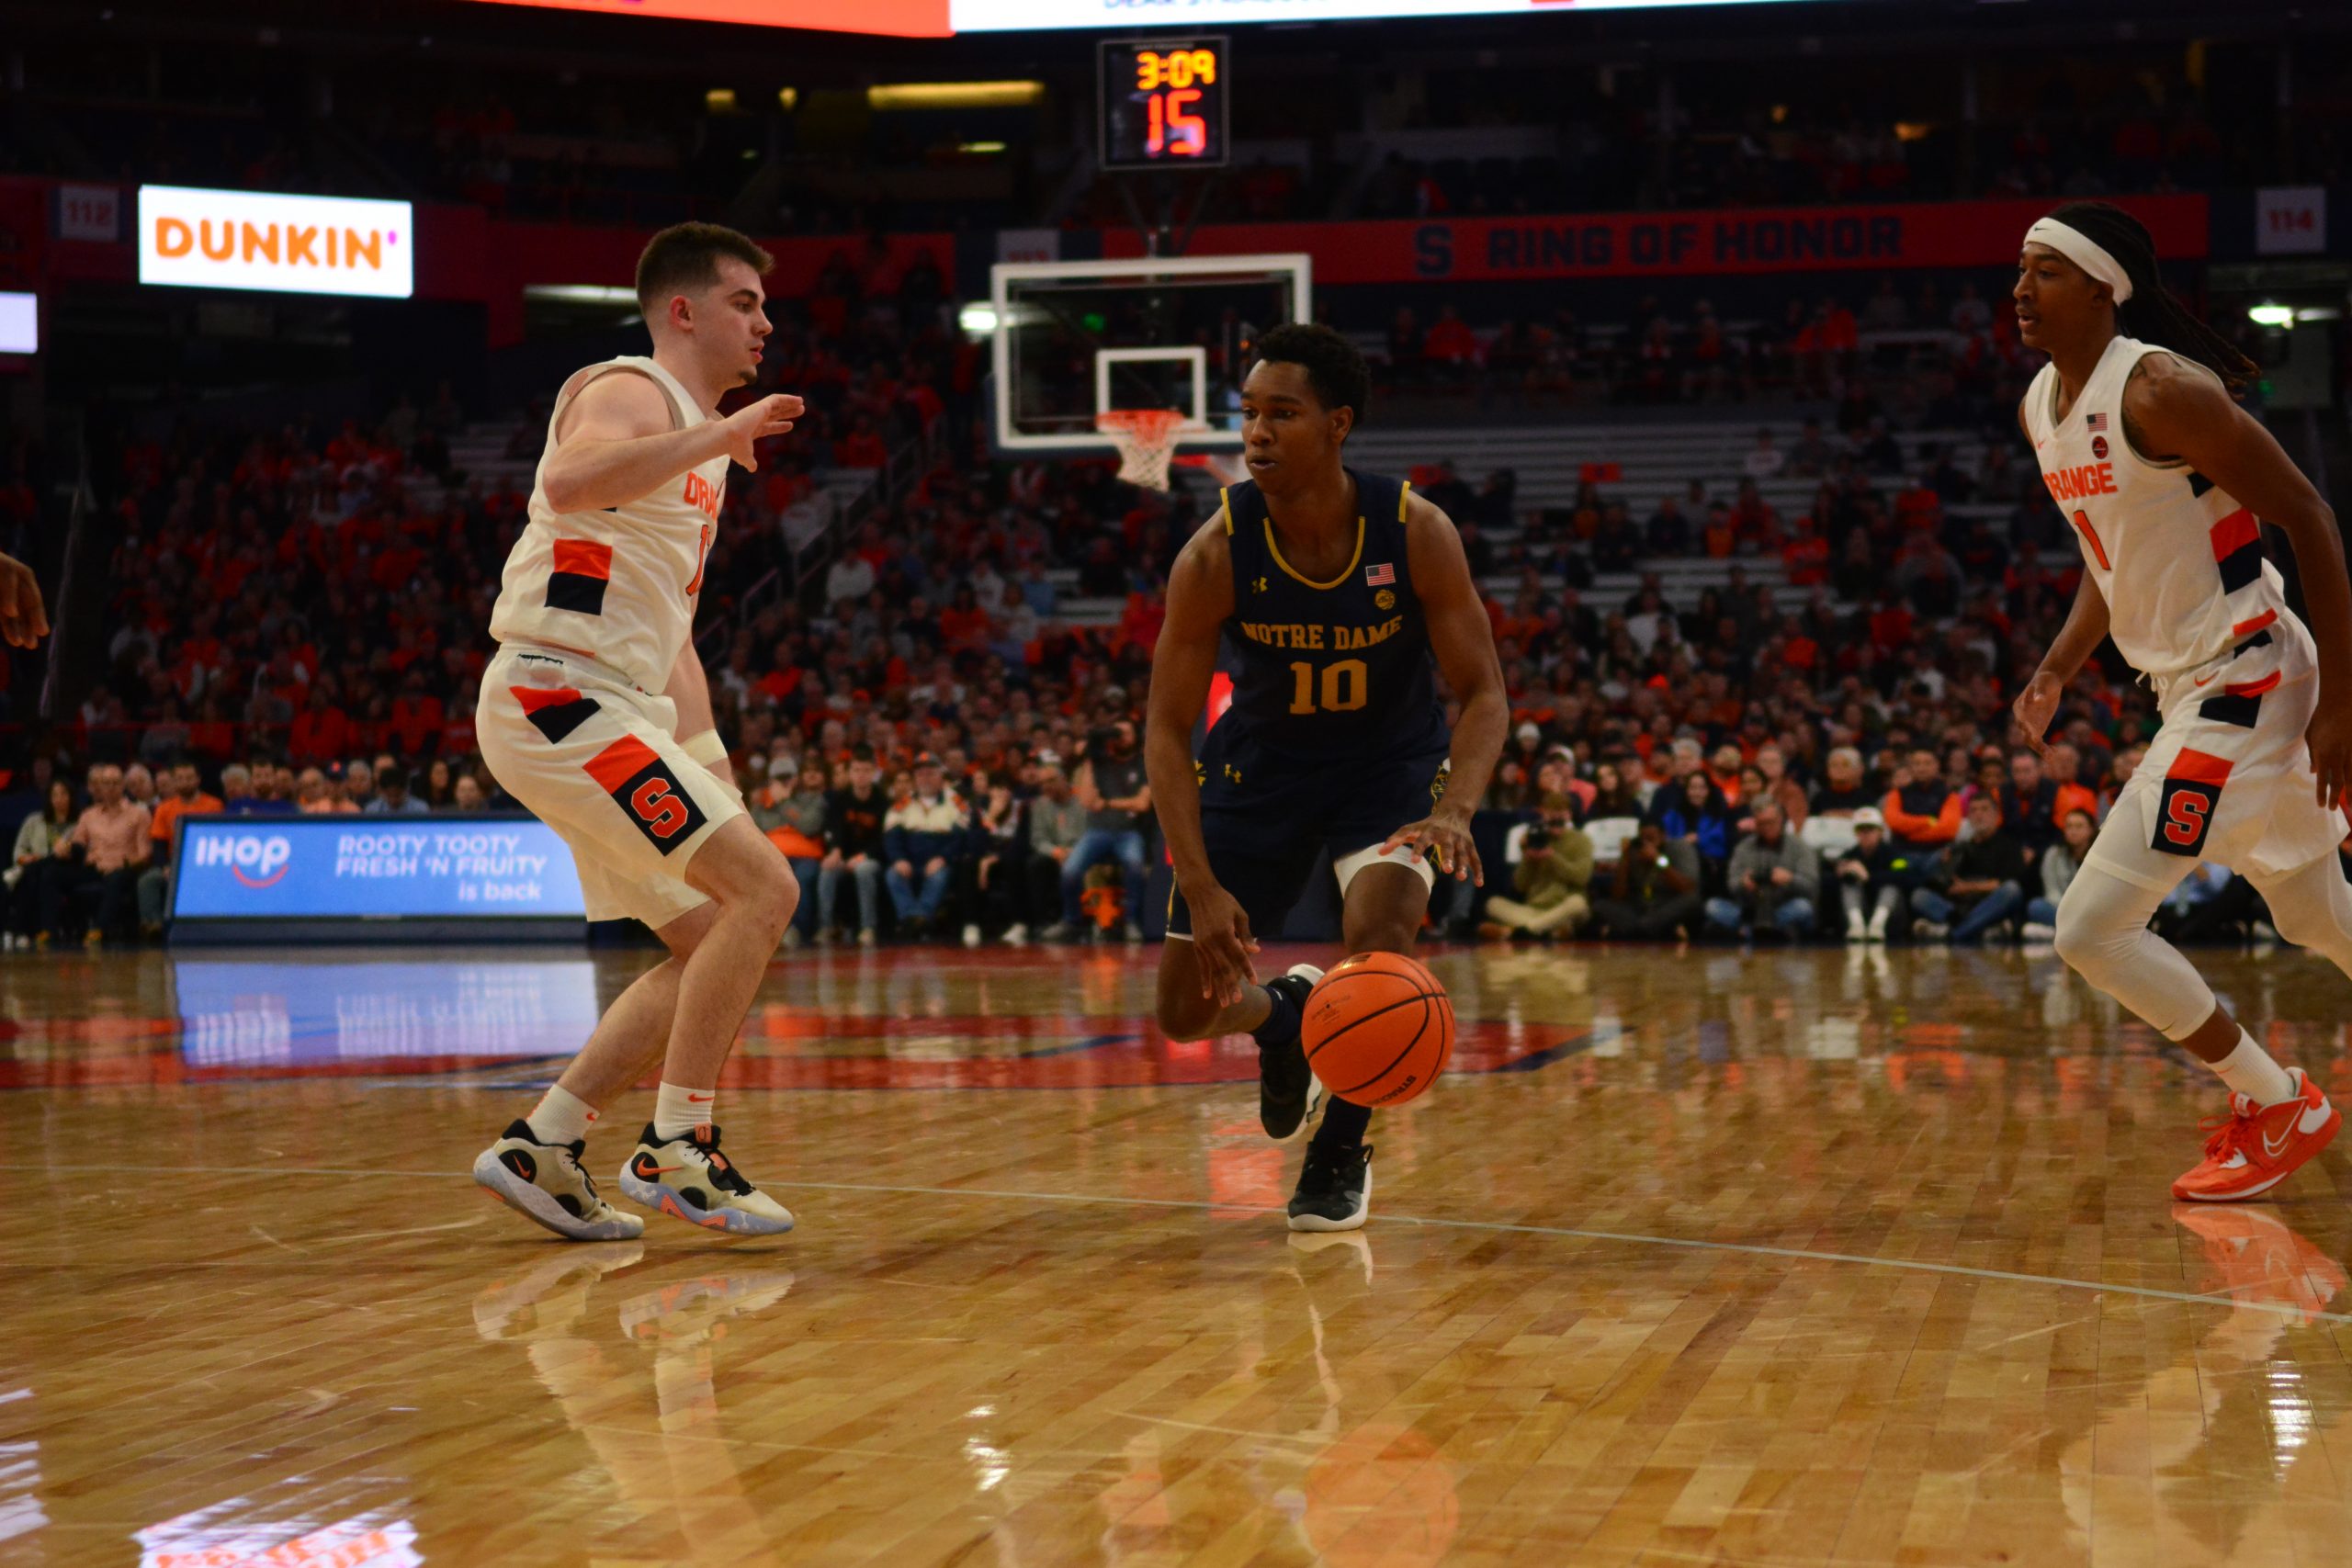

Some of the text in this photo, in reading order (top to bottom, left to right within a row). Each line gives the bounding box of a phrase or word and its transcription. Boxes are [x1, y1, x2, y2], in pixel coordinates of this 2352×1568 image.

[1136, 49, 1216, 89] 3:09
[1148, 88, 1206, 153] 15
[1488, 227, 1612, 268] RING
[1630, 223, 1700, 265] OF
[1714, 217, 1902, 263] HONOR
[2074, 510, 2111, 570] 1
[1240, 614, 1404, 650] NOTRE DAME
[1288, 658, 1368, 715] 10
[631, 777, 689, 839] S
[2164, 789, 2211, 846] S
[335, 855, 418, 877] FRESH
[453, 855, 548, 876] FRUITY
[337, 833, 520, 856] ROOTY TOOTY
[458, 879, 542, 901] is back
